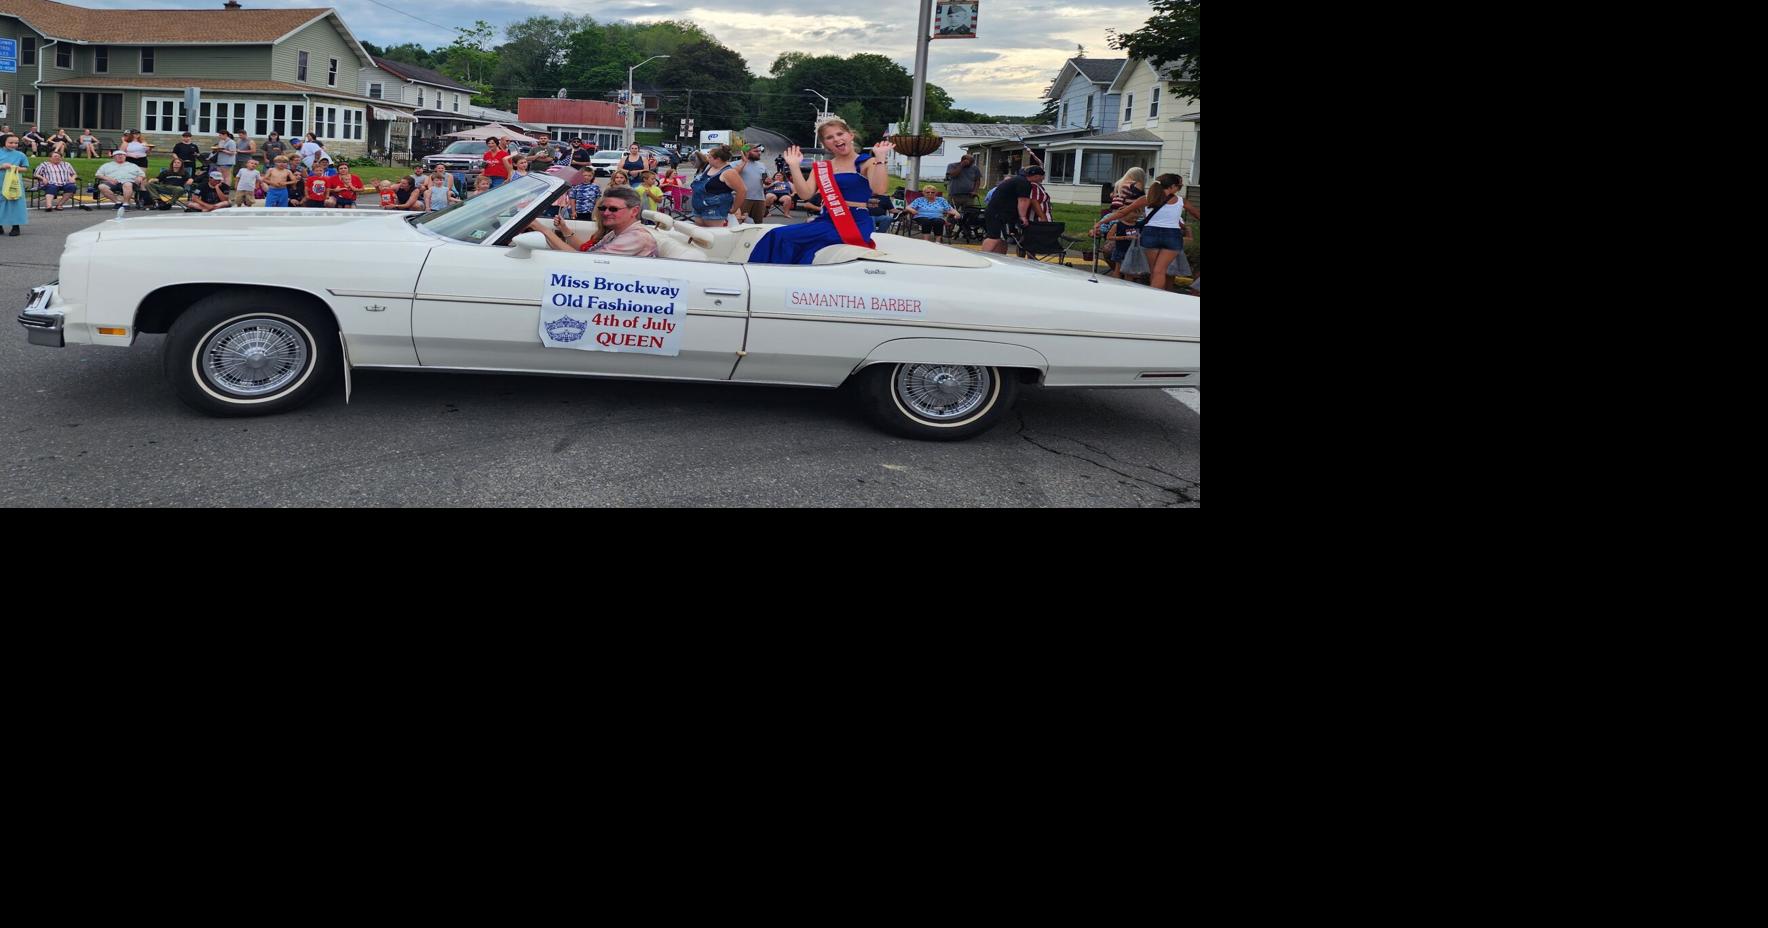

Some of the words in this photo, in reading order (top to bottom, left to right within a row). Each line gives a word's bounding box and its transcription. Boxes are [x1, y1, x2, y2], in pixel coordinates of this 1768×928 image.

[551, 274, 590, 289] Miss
[594, 277, 680, 299] Brockway
[552, 293, 583, 308] Old
[587, 295, 675, 316] Fashioned
[791, 291, 866, 310] SAMANTHA
[871, 297, 922, 313] BARBER
[591, 313, 619, 328] 4th
[623, 316, 640, 328] of
[642, 317, 676, 334] July
[596, 332, 665, 349] QUEEN
